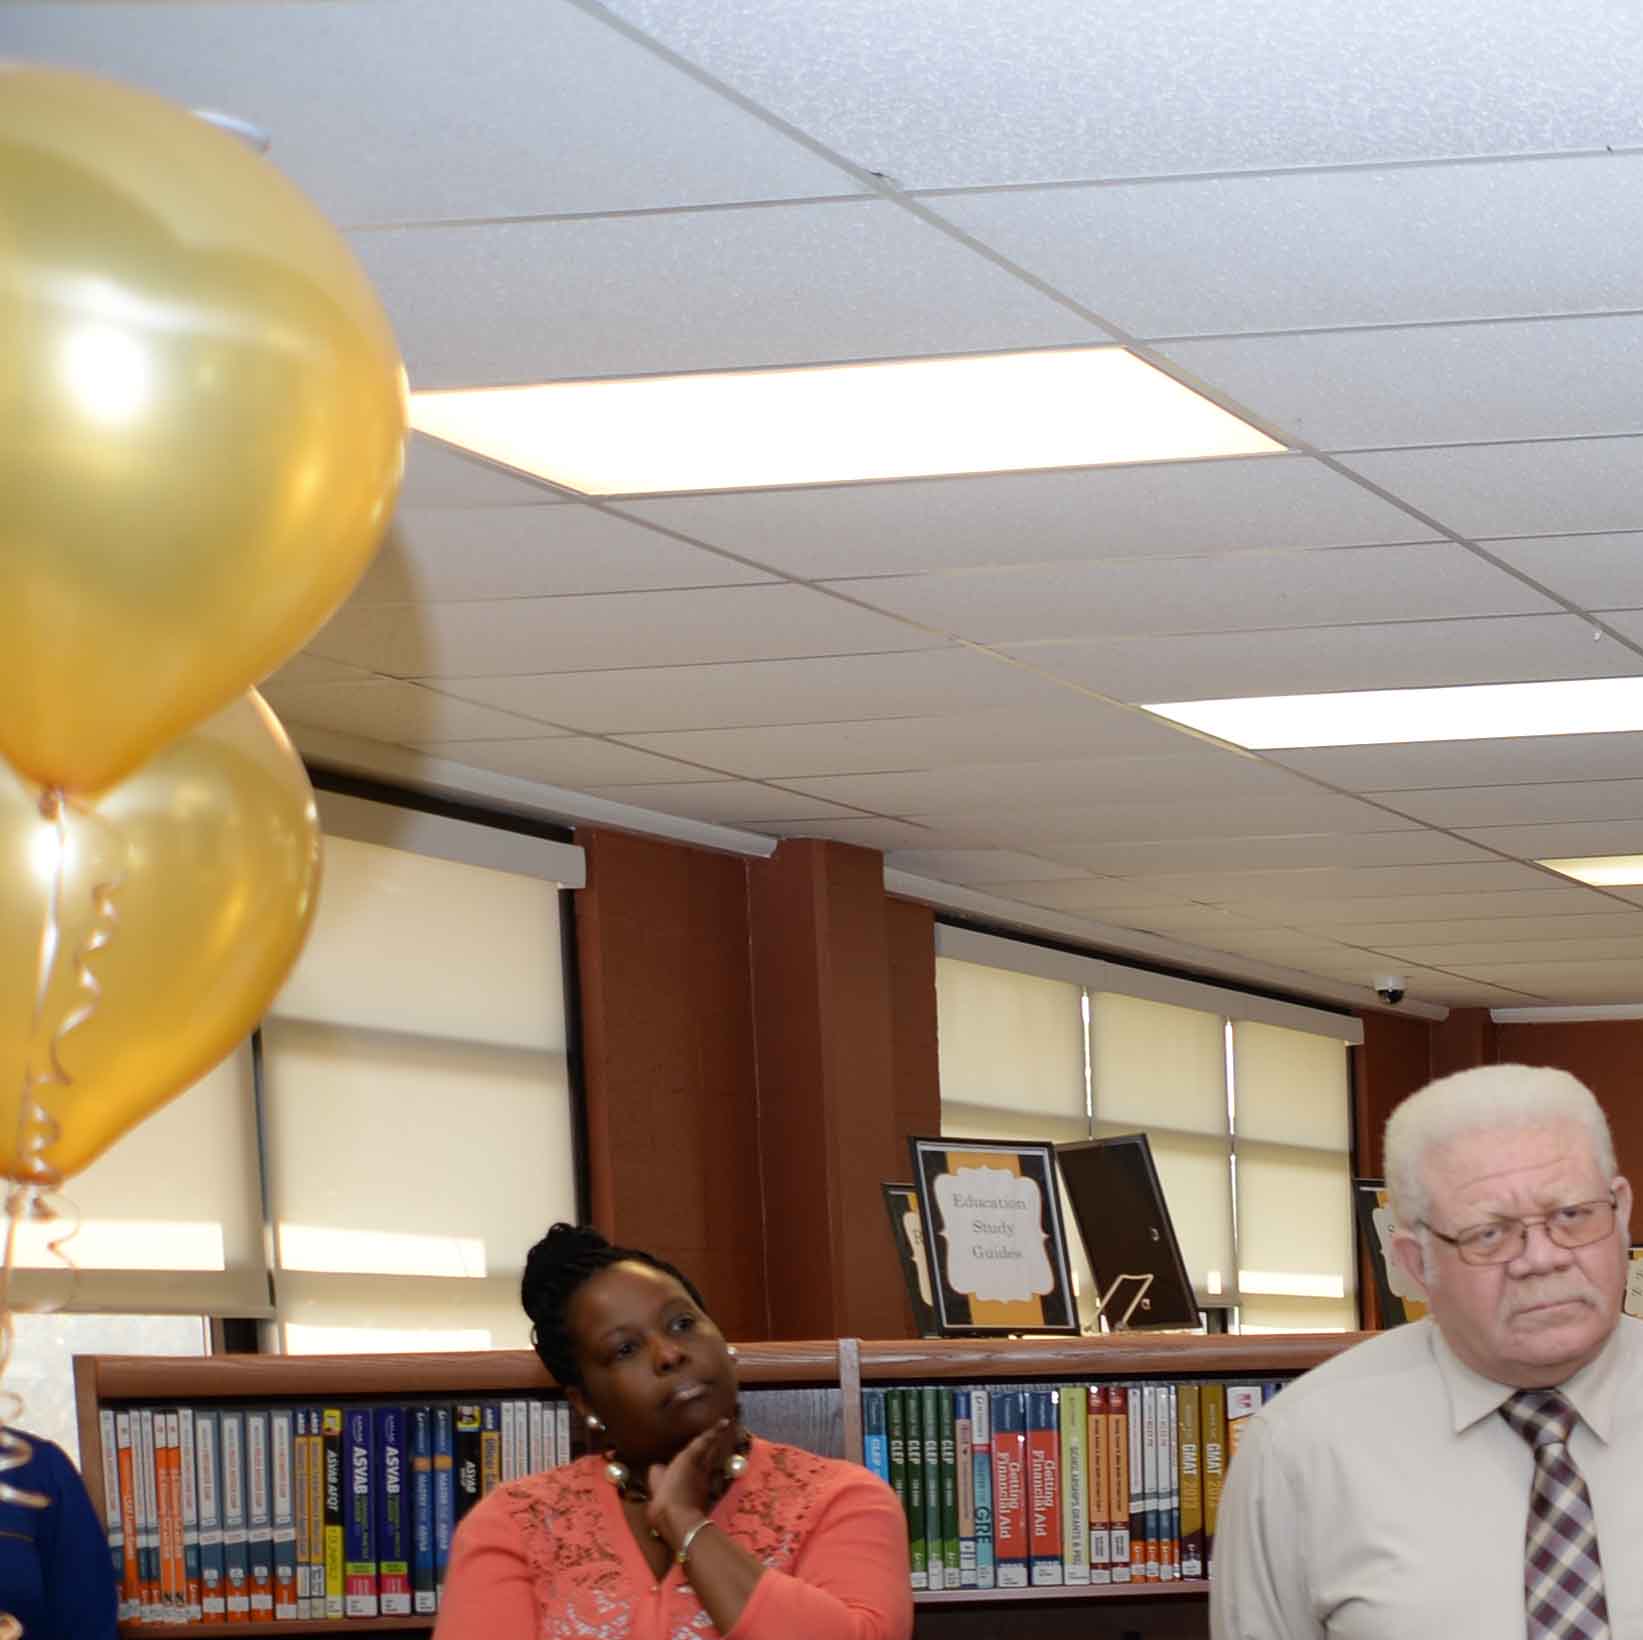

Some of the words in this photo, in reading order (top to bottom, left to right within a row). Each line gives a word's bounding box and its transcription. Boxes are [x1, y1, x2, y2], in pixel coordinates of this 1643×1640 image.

[952, 1193, 1028, 1210] Education
[972, 1220, 1015, 1235] Study
[971, 1245, 1023, 1260] Guides
[327, 1450, 338, 1483] ASVAB
[891, 1440, 904, 1464] CLEP
[908, 1440, 921, 1464] CLEP
[925, 1440, 939, 1464] CLEP
[941, 1440, 955, 1464] CLEP
[1182, 1443, 1198, 1475] GMAT
[1206, 1443, 1222, 1474] GMAT
[352, 1446, 368, 1494] ASVAB
[385, 1446, 399, 1494] ASVAB
[465, 1460, 476, 1493] ASVAB
[998, 1452, 1010, 1513] Financial
[1008, 1462, 1021, 1509] Getting
[1031, 1449, 1045, 1511] Financial
[1043, 1460, 1056, 1507] Getting
[328, 1485, 338, 1511] AFQT
[975, 1506, 991, 1544] GRE
[999, 1516, 1011, 1538] Aid
[1034, 1514, 1046, 1536] Aid
